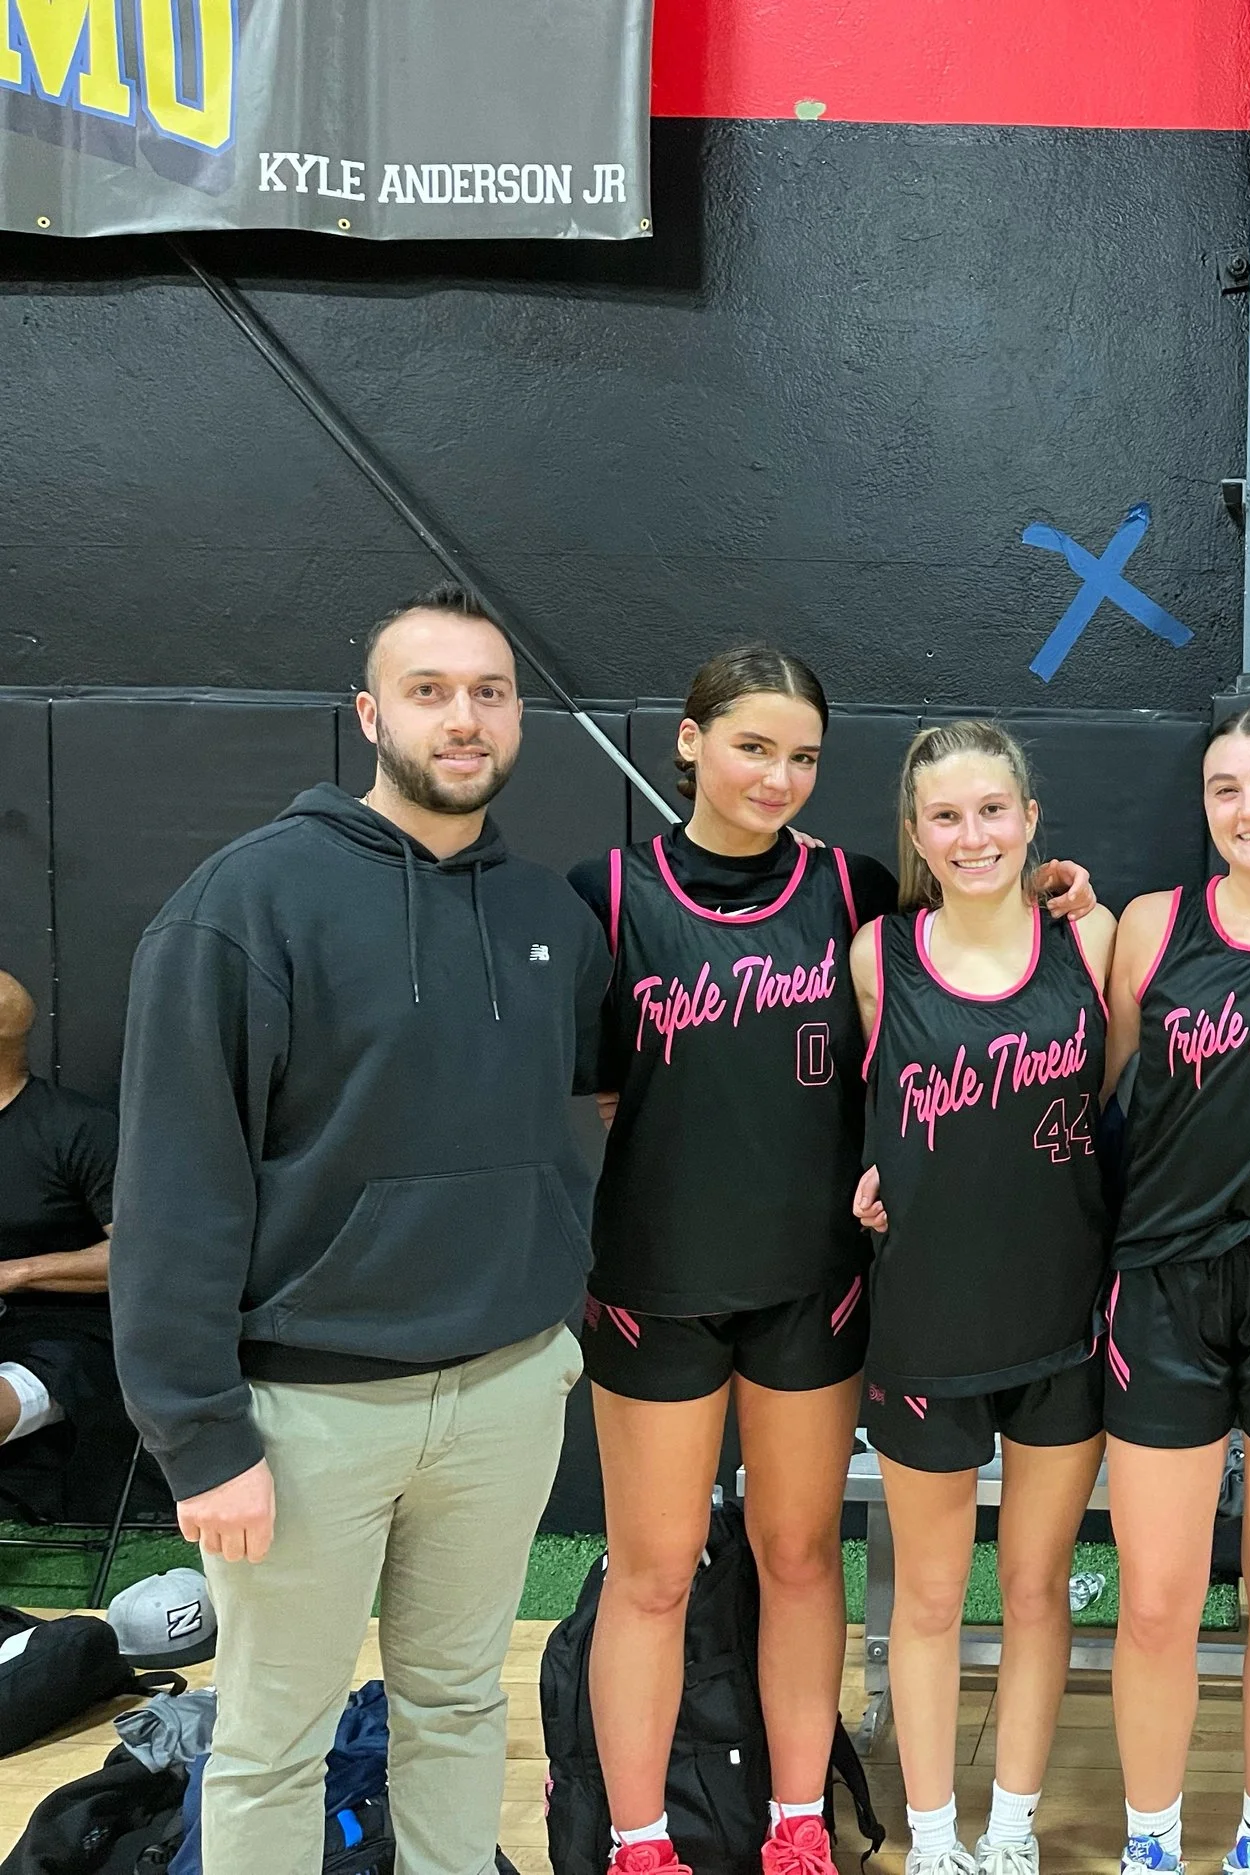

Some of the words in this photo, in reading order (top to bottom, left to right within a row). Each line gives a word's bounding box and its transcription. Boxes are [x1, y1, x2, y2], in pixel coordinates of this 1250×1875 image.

[258, 152, 366, 202] KYLE
[378, 163, 573, 205] ANDERSON
[582, 163, 627, 204] JR
[633, 961, 727, 1065] Triple
[732, 937, 836, 1028] Threat
[1164, 991, 1249, 1090] Triple
[796, 1022, 834, 1087] 0
[899, 1044, 984, 1152] Triple
[988, 1007, 1087, 1110] Threat
[1033, 1093, 1096, 1163] 44
